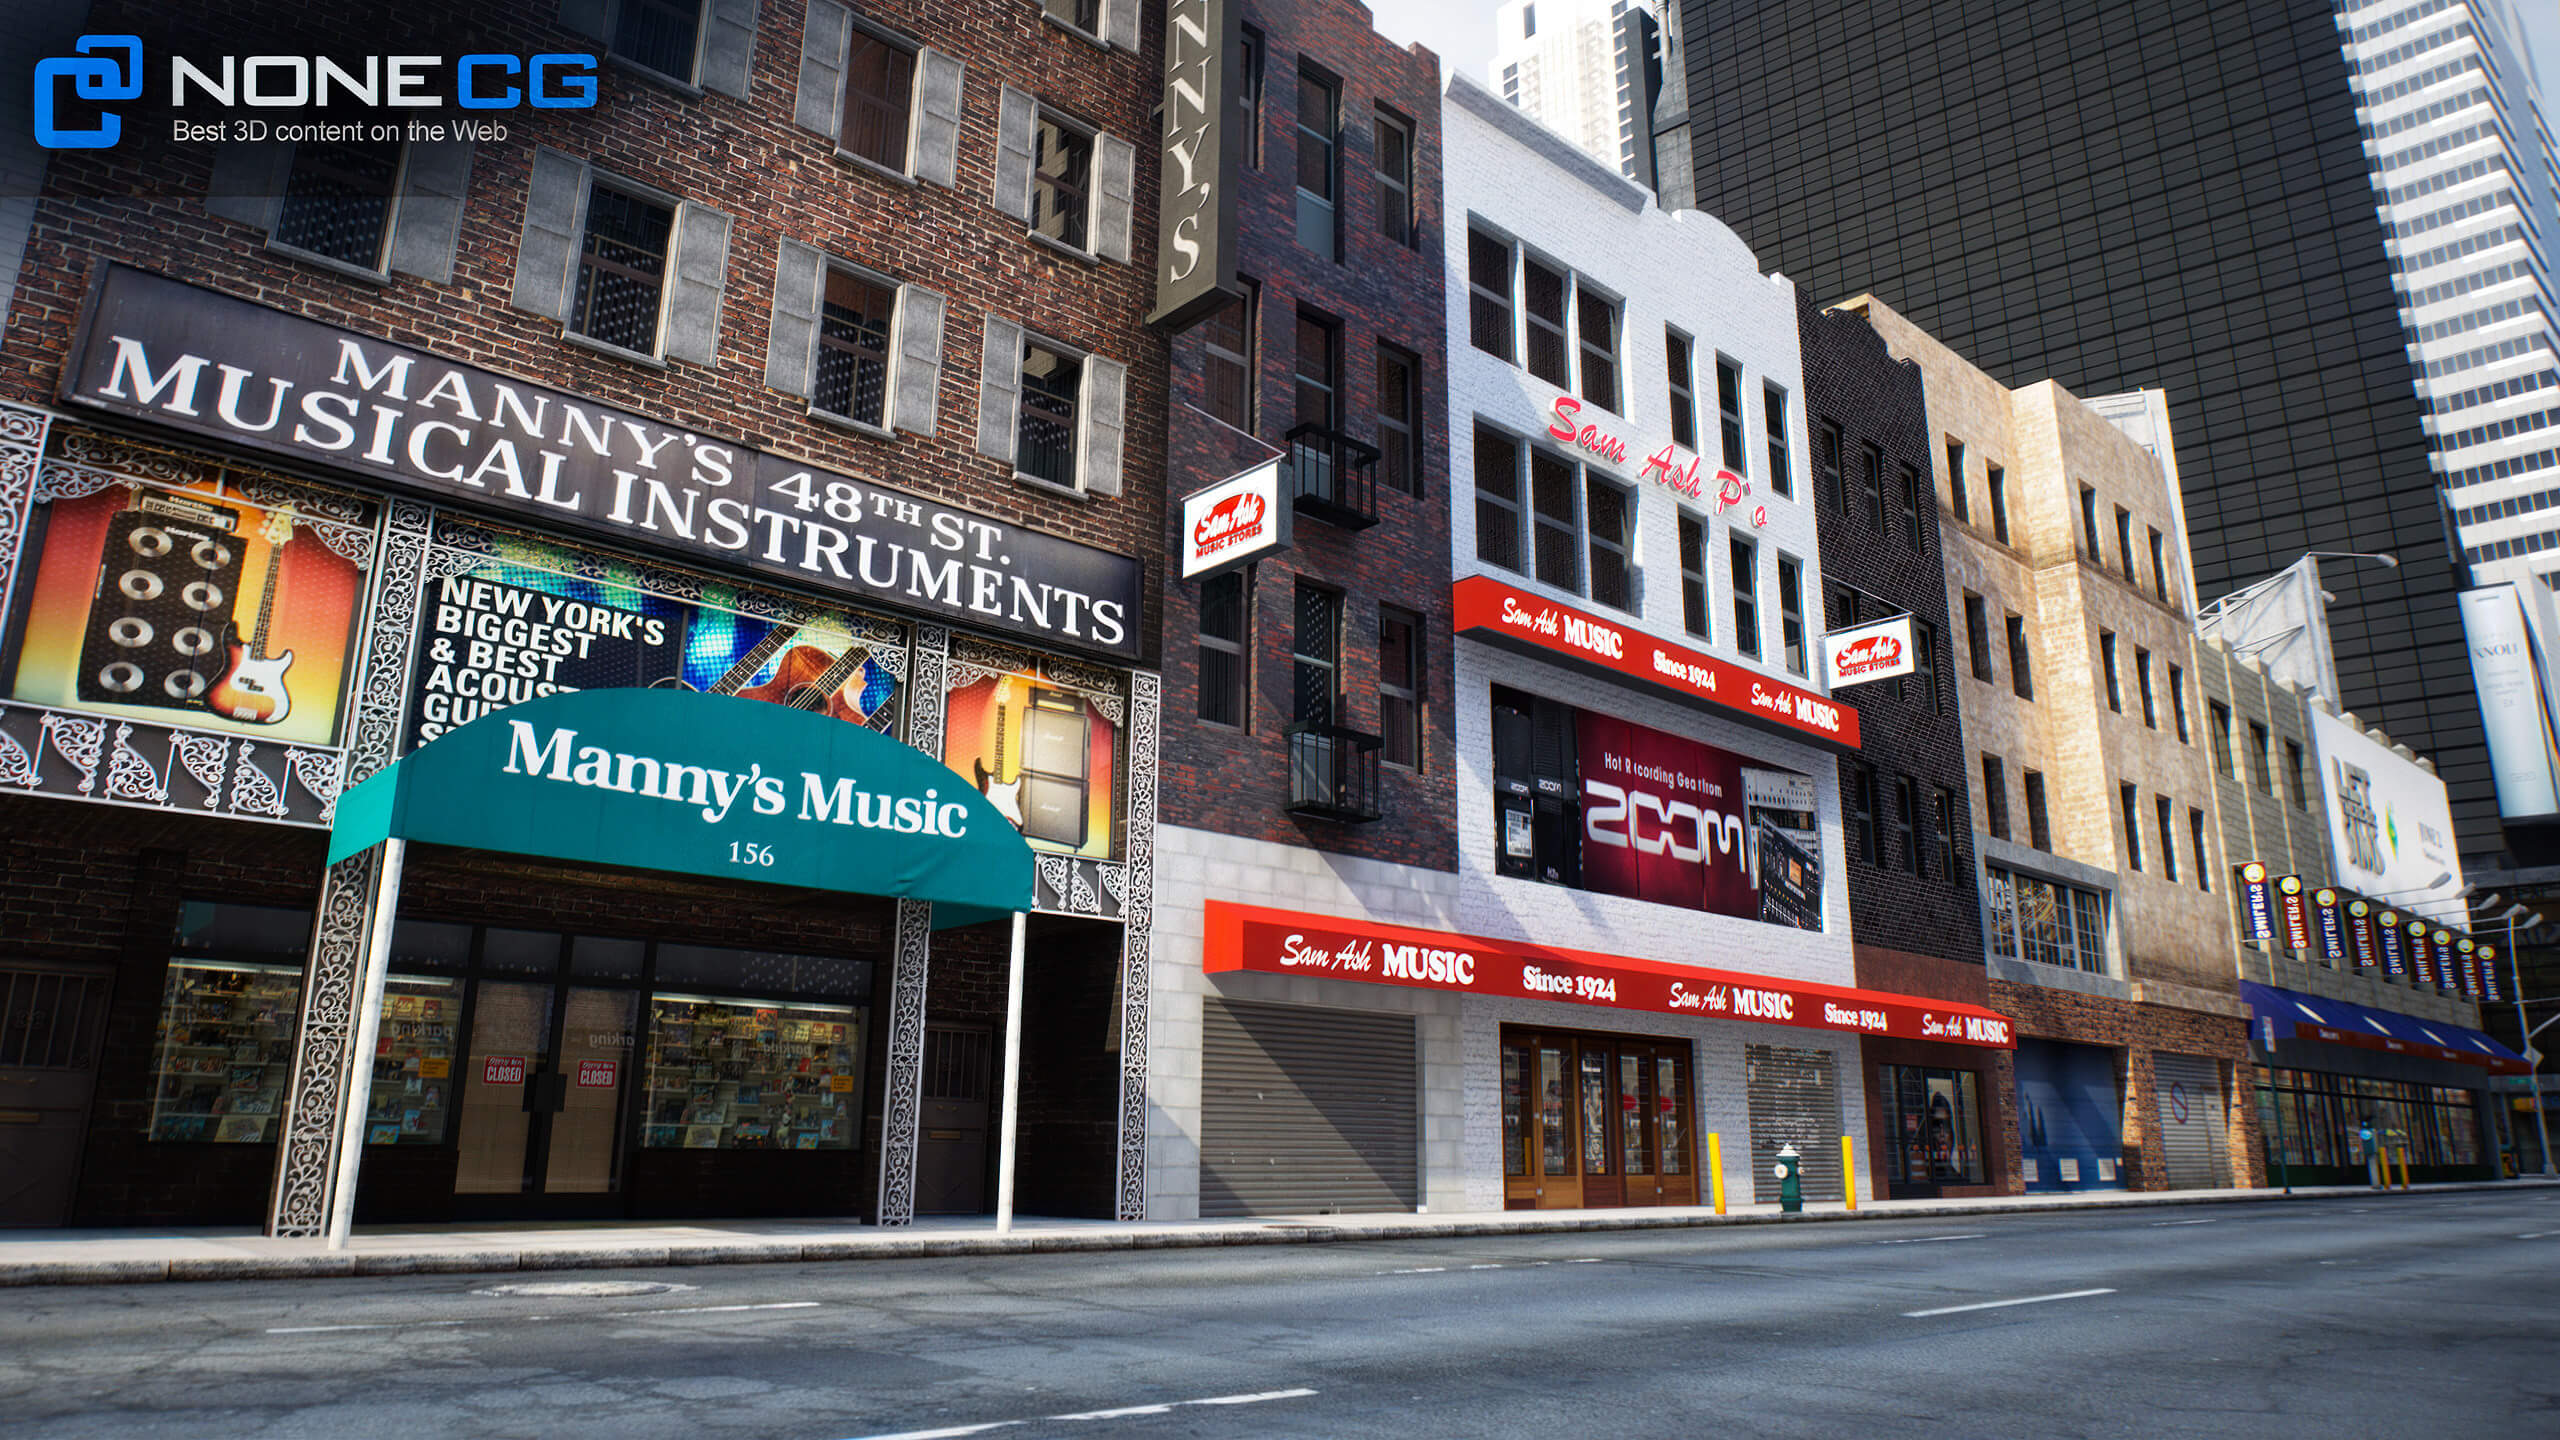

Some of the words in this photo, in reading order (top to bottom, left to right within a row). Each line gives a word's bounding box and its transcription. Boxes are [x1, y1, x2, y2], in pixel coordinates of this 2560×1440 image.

[1168, 0, 1213, 284] NNY'S
[329, 339, 735, 488] MANNY'S
[1549, 397, 1628, 463] Sam
[1641, 444, 1703, 498] Ash
[97, 336, 581, 511] MUSICAL
[605, 470, 1126, 646] INSTRUMENTS
[767, 472, 922, 526] 48TH
[930, 512, 1010, 566] ST.
[1197, 504, 1230, 545] Sam
[1229, 492, 1261, 531] Ash
[1196, 539, 1225, 559] MUSIC
[1228, 523, 1263, 546] STORES
[436, 604, 596, 660] BIGGEST
[440, 577, 533, 619] NEW
[542, 596, 666, 647] YORK'S
[430, 637, 456, 664] &
[468, 640, 564, 682] BEST
[1501, 597, 1533, 627] Sam
[1535, 606, 1559, 636] Ash
[1563, 615, 1623, 660] MUSIC
[1653, 649, 1687, 681] Since
[1688, 661, 1717, 692] 1924
[1751, 683, 1773, 711] Sam
[1774, 692, 1793, 716] Ash
[1795, 697, 1840, 732] MUSIC
[1839, 666, 1867, 678] MUSIC
[1869, 658, 1901, 671] STORES
[1840, 641, 1870, 667] Sam
[503, 720, 785, 823] Manny's
[797, 772, 968, 839] Music
[1604, 752, 1622, 772] Hot
[729, 841, 775, 867] 156
[1280, 933, 1330, 967] Sam
[1331, 938, 1372, 972] Ash
[1381, 943, 1475, 985] MUSIC
[1523, 964, 1573, 995] Since
[1575, 974, 1617, 1002] 1924
[1669, 981, 1700, 1009] Sam
[1701, 984, 1727, 1012] Ash
[1732, 987, 1794, 1020] MUSIC
[1823, 1002, 1858, 1027] Since
[1859, 1009, 1888, 1032] 1924
[1921, 1013, 1944, 1037] Sam
[1944, 1014, 1962, 1038] Ash
[1964, 1017, 2009, 1044] MUSIC
[486, 1066, 522, 1083] CLOSED
[580, 1069, 614, 1085] CLOSED
